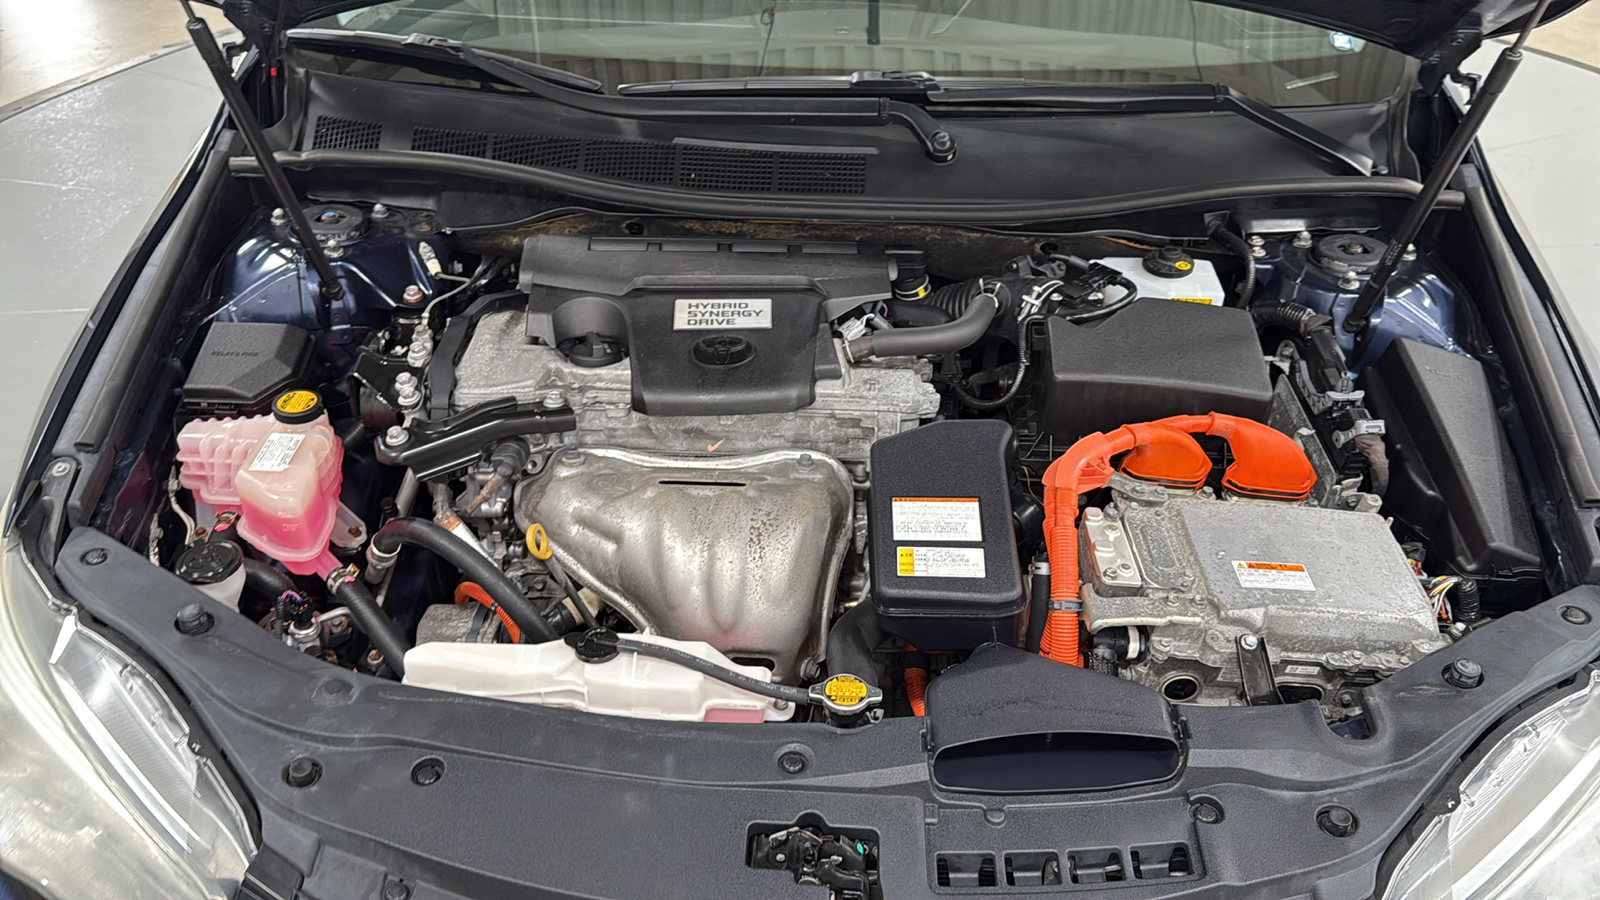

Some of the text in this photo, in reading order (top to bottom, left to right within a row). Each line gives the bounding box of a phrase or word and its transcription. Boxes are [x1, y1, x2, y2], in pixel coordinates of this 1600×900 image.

[687, 302, 749, 310] HYBRID
[687, 310, 764, 318] SYNERGY
[687, 318, 737, 326] DRIVE
